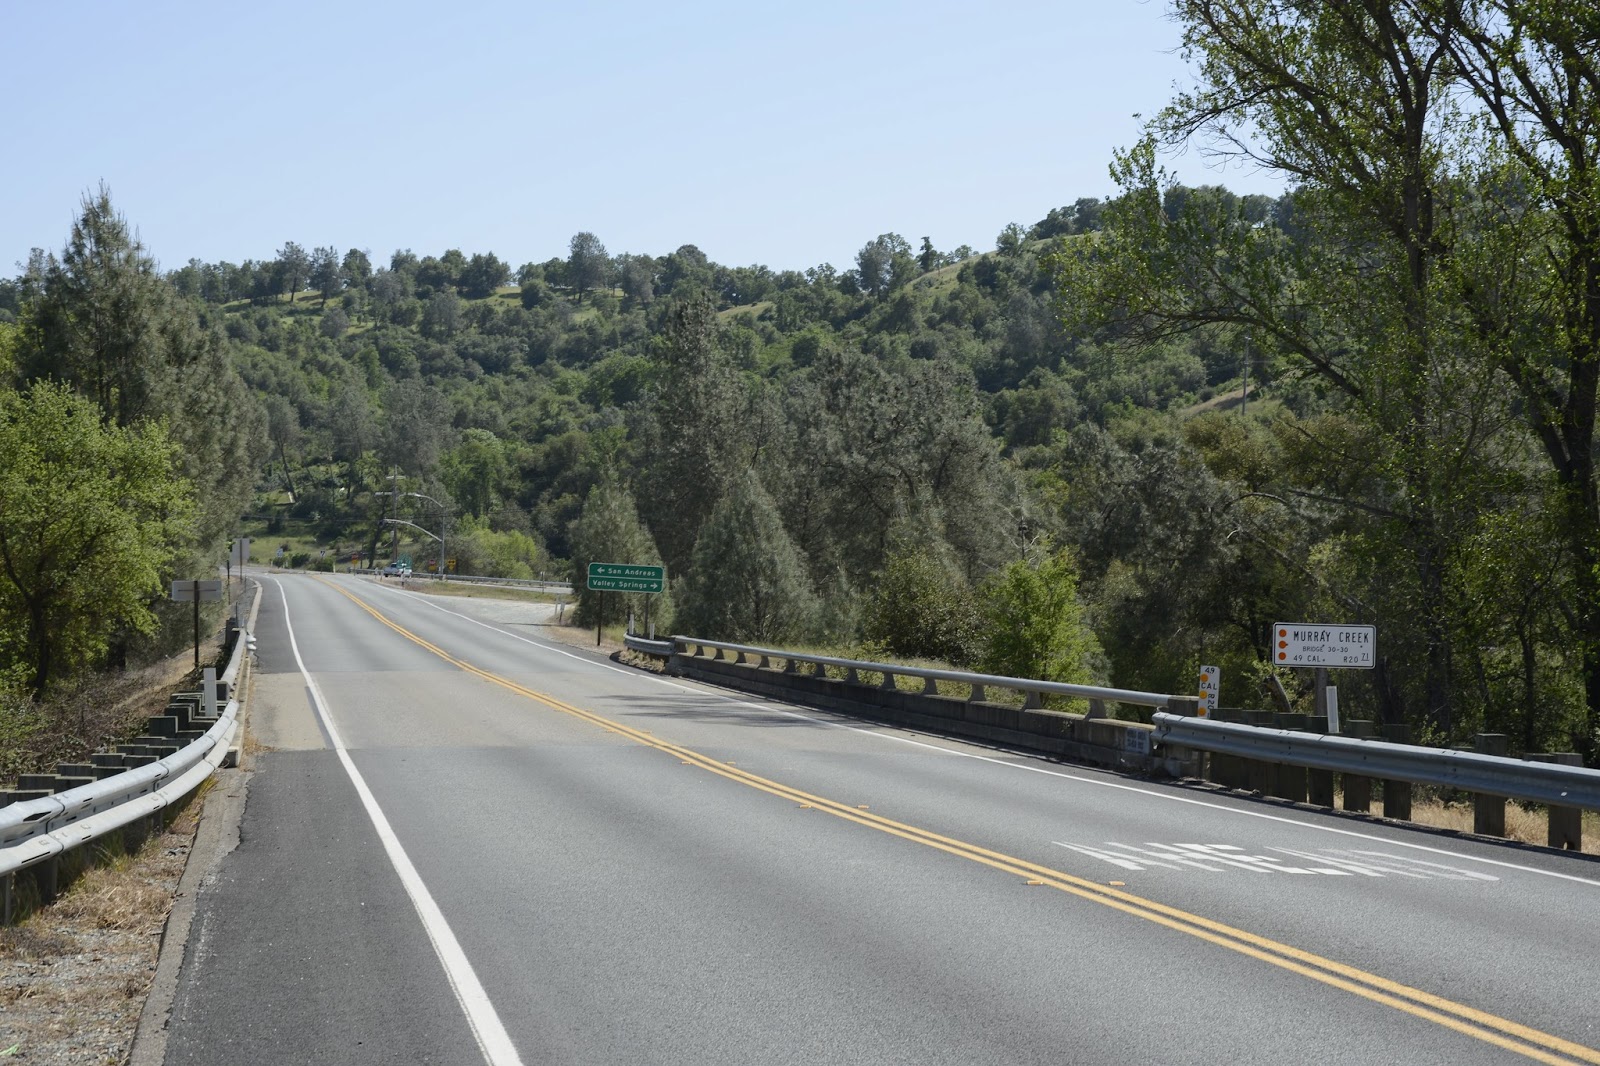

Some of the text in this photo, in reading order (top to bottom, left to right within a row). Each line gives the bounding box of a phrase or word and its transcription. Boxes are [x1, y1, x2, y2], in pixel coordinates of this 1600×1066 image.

[608, 567, 656, 577] San Andreas
[592, 579, 647, 590] Valley Springs
[1293, 630, 1369, 643] MURRAY CREEK
[1293, 654, 1303, 662] 49
[1204, 667, 1215, 675] 49
[1200, 682, 1217, 690] CAL
[1050, 840, 1500, 882] AHEAD
